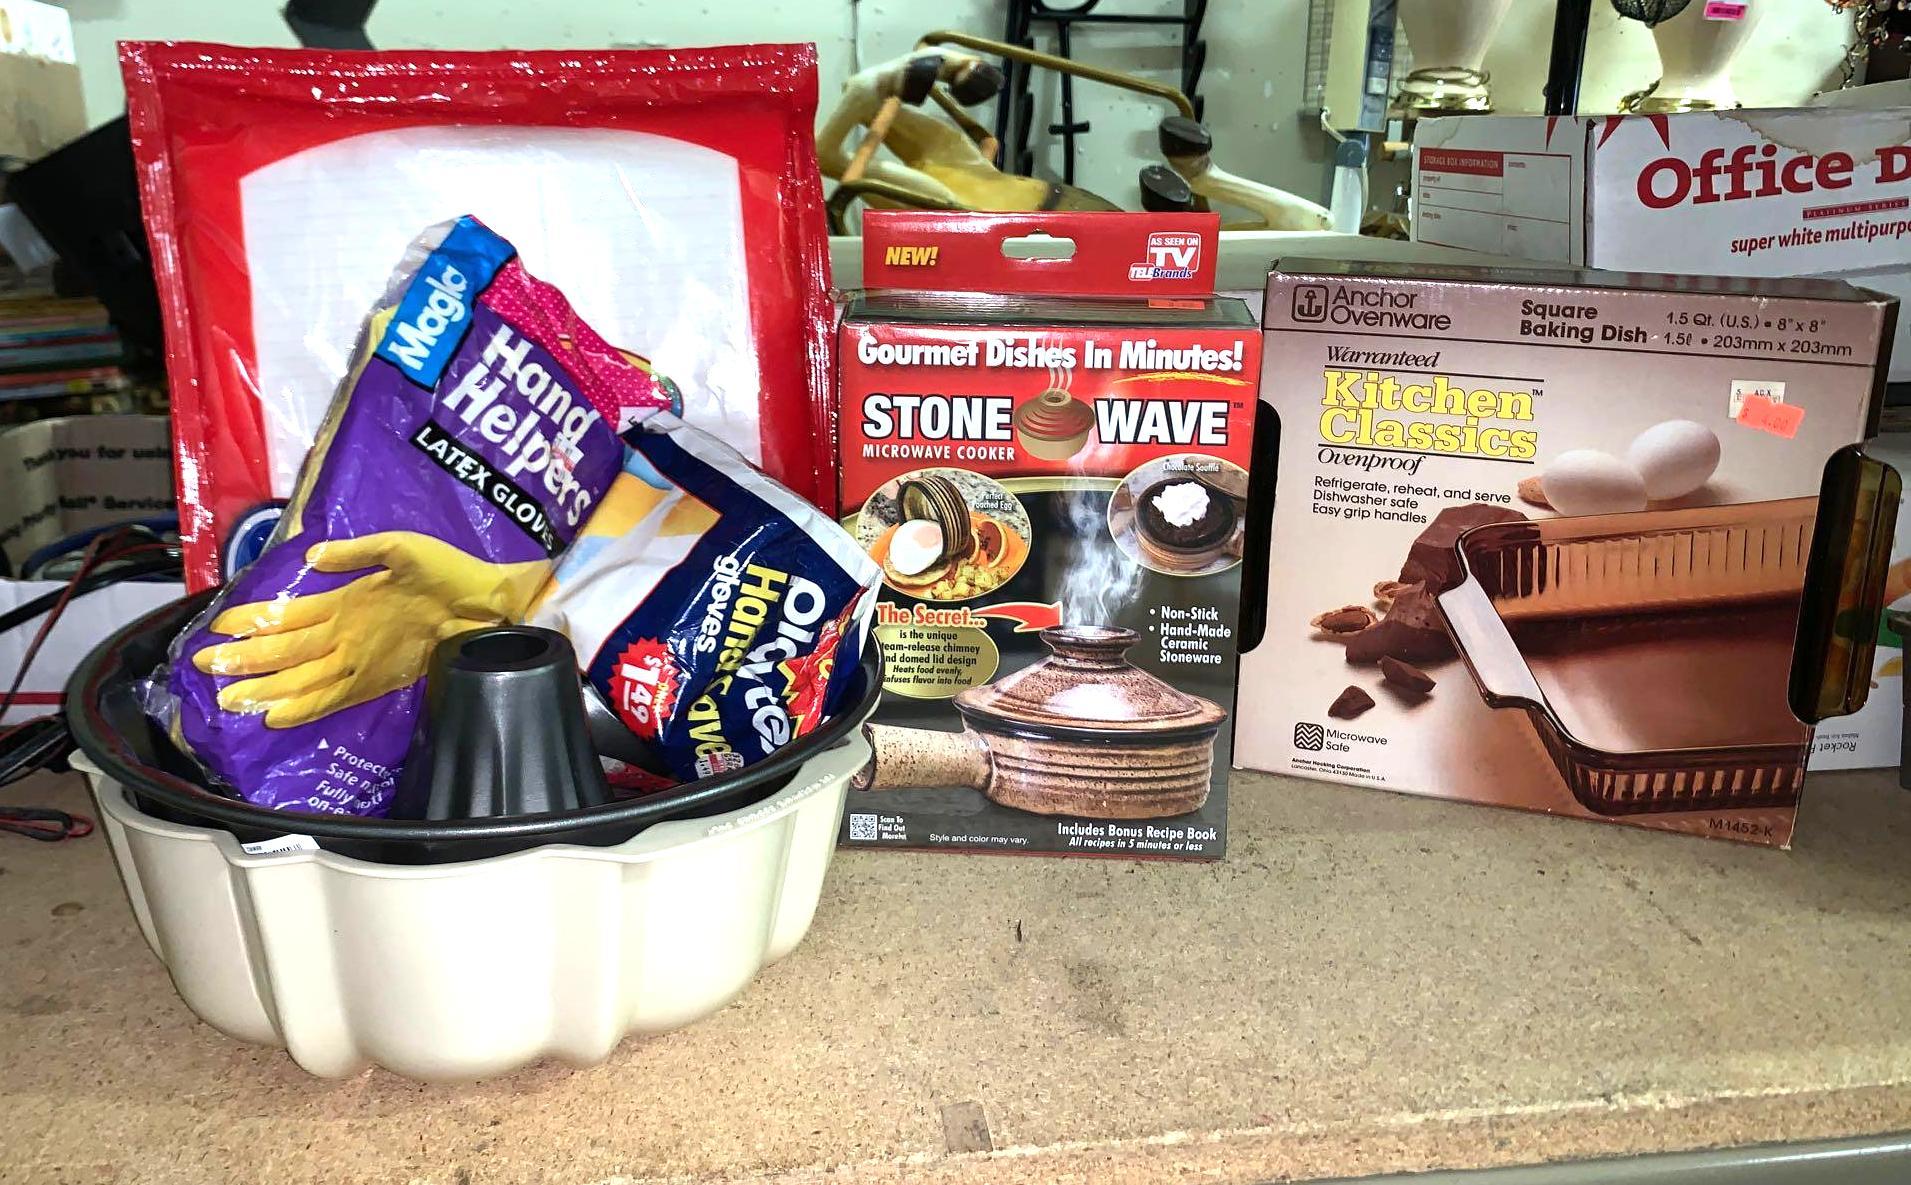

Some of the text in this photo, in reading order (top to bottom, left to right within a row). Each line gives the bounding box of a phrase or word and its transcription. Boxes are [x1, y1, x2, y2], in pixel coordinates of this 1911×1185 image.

[1637, 143, 1854, 209] Office
[1150, 237, 1199, 246] AS SEEN ON
[1730, 219, 1911, 257] super white multipurpo
[885, 246, 937, 266] NEW!
[1150, 246, 1197, 268] TV
[1331, 285, 1418, 309] Anchor
[388, 264, 469, 371] Magla
[1330, 304, 1452, 331] Ovenware
[1521, 299, 1599, 320] Square
[1520, 319, 1648, 344] Baking Dish
[1666, 311, 1689, 326] 1.5
[1719, 313, 1761, 331] (U.S.)
[1795, 321, 1804, 332] x
[856, 336, 1244, 371] Gourmet Dishes In Minutes!
[1326, 345, 1441, 368] Warranteed
[1712, 335, 1774, 352] 203mm
[1776, 341, 1787, 352] x
[1790, 339, 1853, 357] 203mm
[479, 322, 601, 447] Hand
[1321, 369, 1535, 421] Kitchen
[861, 393, 1015, 442] STONE
[1094, 398, 1229, 445] WAVE
[1319, 407, 1538, 459] Classics
[441, 361, 592, 527] Helpers
[862, 443, 1015, 461] MICROWAVE COOKER
[415, 427, 487, 484] LATEX
[1317, 447, 1426, 476] Ovenproof
[1313, 490, 1419, 509] Dishwasher safe
[1315, 475, 1512, 503] Refrigerate, reheat, and serve
[1312, 504, 1427, 524] Easy grip handles
[696, 554, 744, 654] gloves
[1161, 605, 1218, 621] Non-Stick
[876, 603, 986, 627] The Secret...
[900, 630, 958, 641] is the unique
[1160, 622, 1231, 638] Hand-Made
[880, 642, 980, 654] team-release chimney
[1160, 636, 1208, 651] Ceramic
[884, 653, 977, 667] nd domed lid design
[1160, 650, 1222, 664] Stoneware
[893, 665, 915, 674] Heats
[916, 665, 935, 675] food
[912, 675, 935, 685] flavor
[936, 676, 953, 685] into
[954, 676, 973, 686] food
[1326, 729, 1388, 745] Microwave
[1326, 740, 1350, 752] Safe
[1819, 740, 1857, 753] Rocket
[326, 762, 359, 786] Safe
[315, 779, 355, 806] Fully
[878, 824, 906, 832] Find Out
[880, 815, 904, 824] Scan To
[1709, 818, 1773, 837] M1452-K
[929, 833, 1030, 846] Style and color may vary.
[1057, 822, 1217, 842] Includes Bonus Recipe Book
[1068, 837, 1082, 847] All
[1083, 838, 1115, 849] recipes
[1117, 839, 1127, 848] in
[1136, 840, 1171, 850] minutes
[1185, 841, 1203, 852] less
